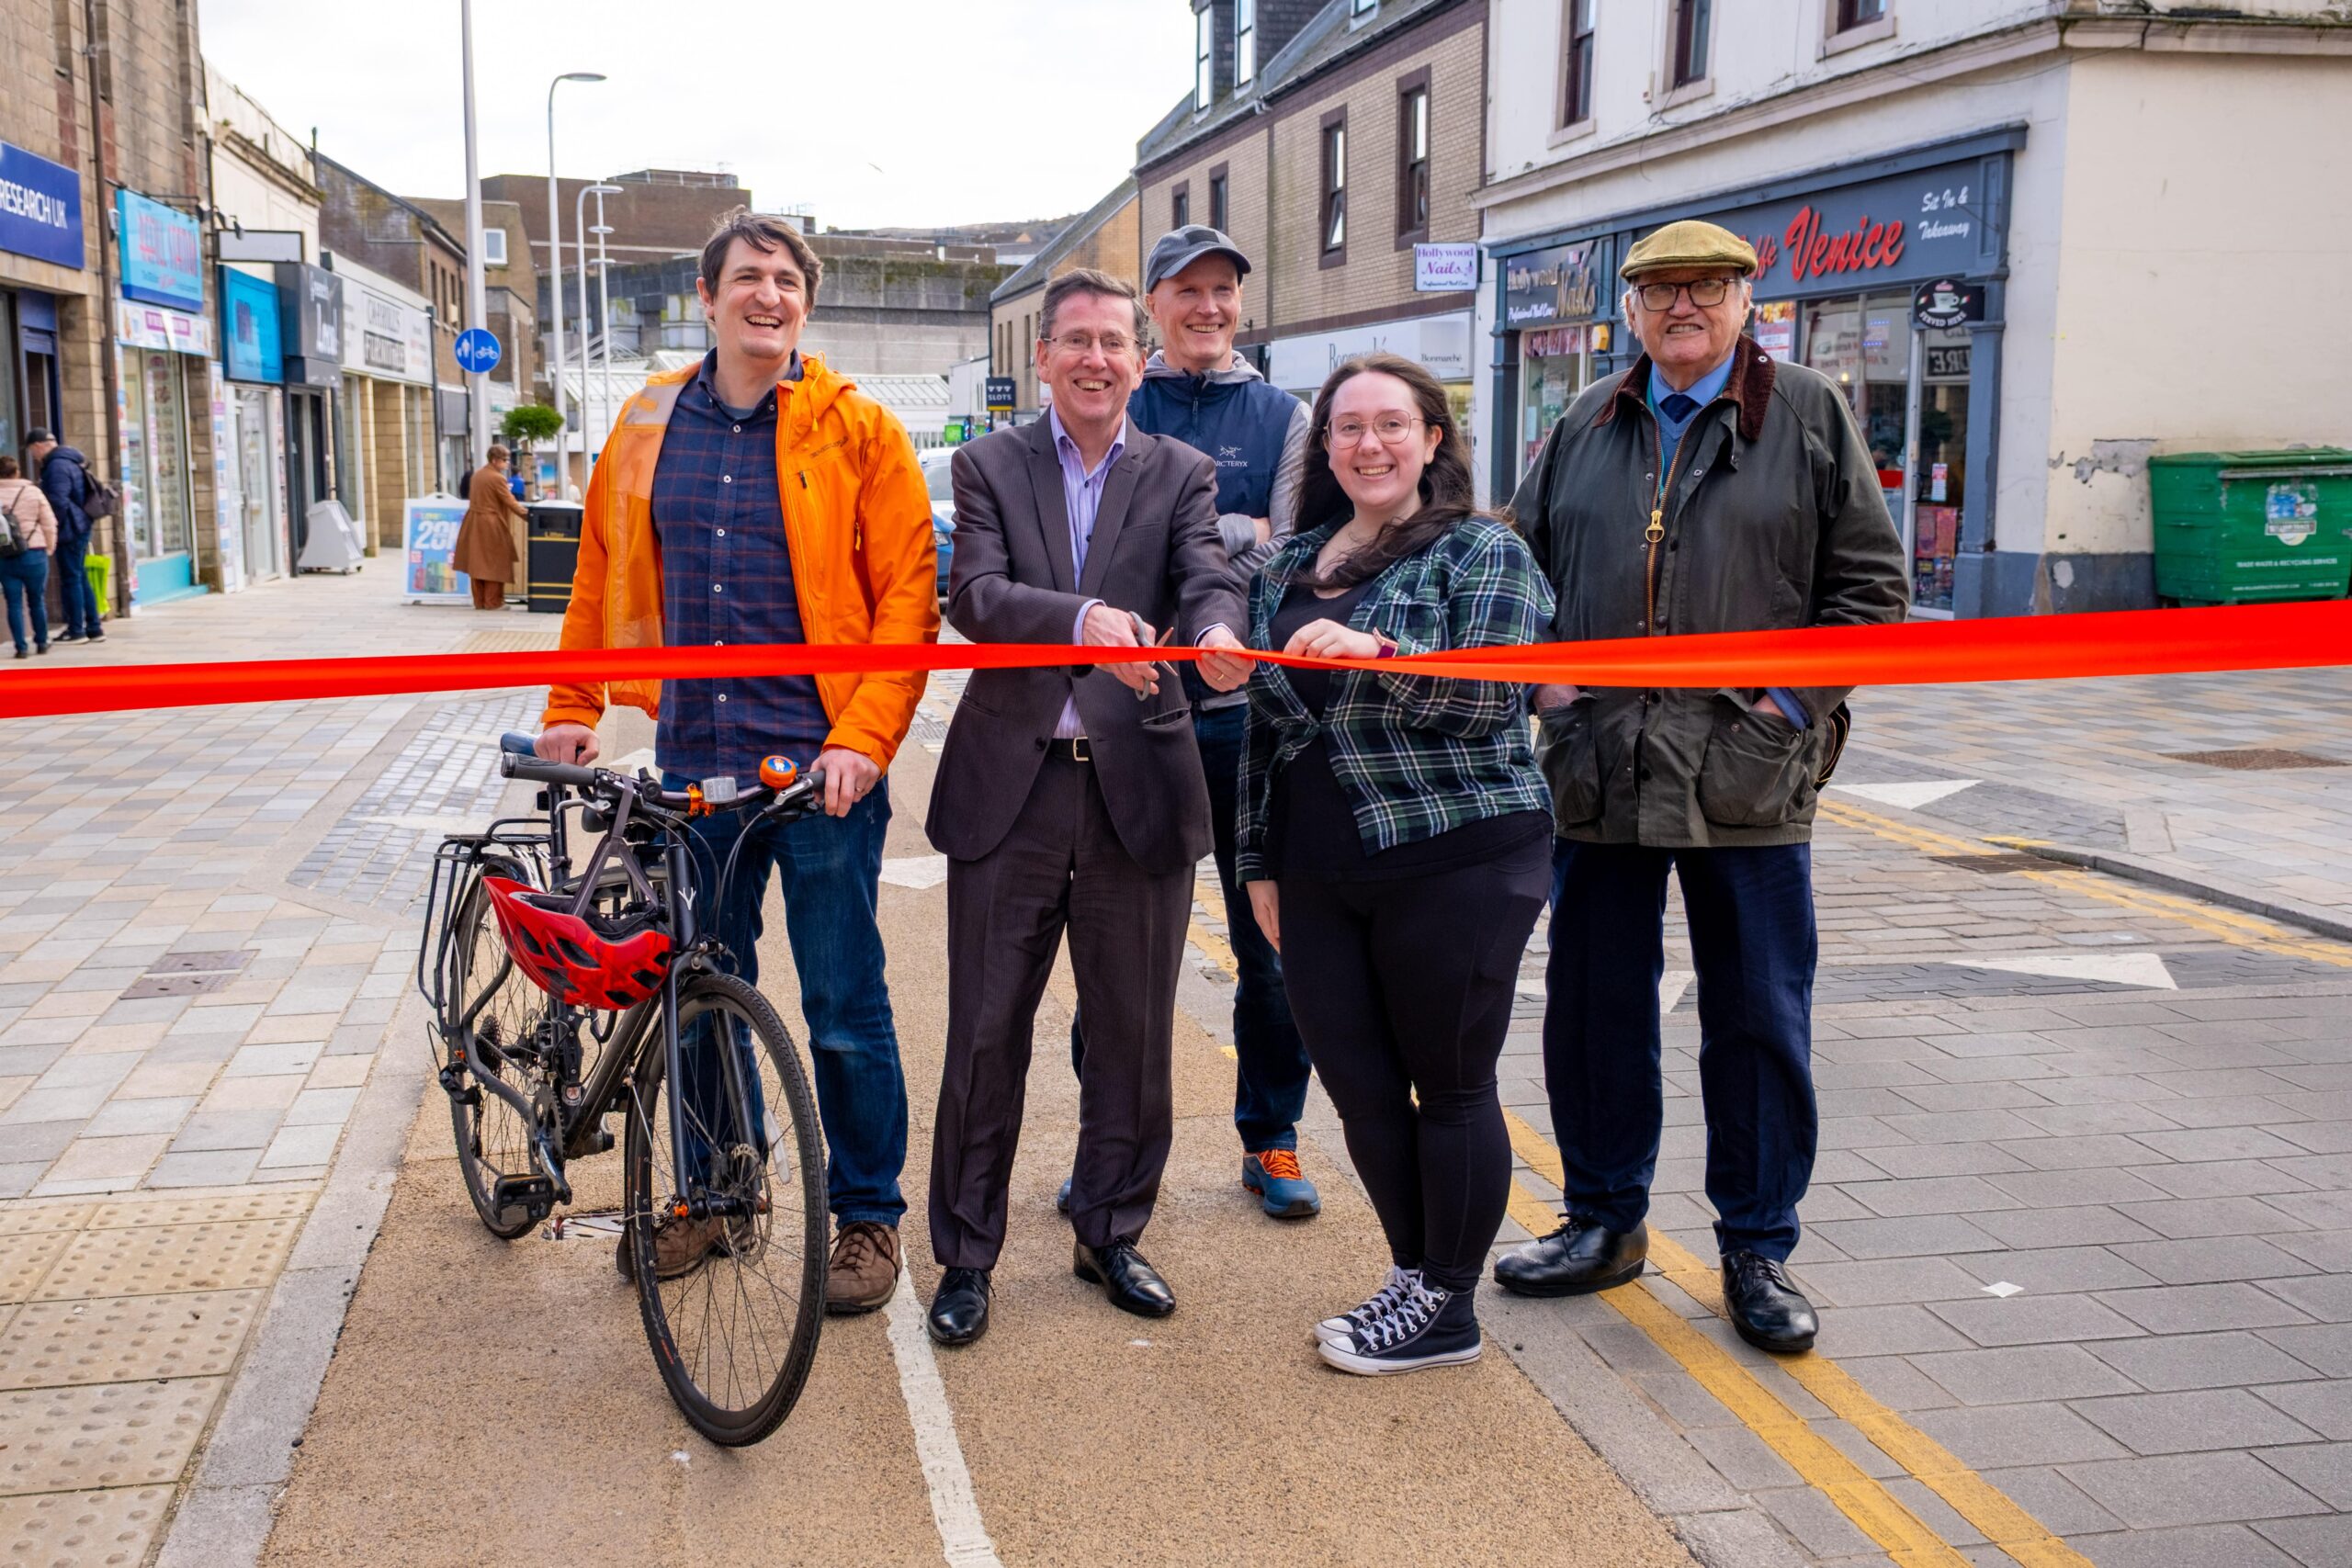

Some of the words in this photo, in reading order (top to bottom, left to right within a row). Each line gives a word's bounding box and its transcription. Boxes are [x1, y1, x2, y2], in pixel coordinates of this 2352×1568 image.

[1921, 191, 1939, 213] Sit
[1941, 188, 1956, 209] In
[1957, 186, 1969, 205] &
[51, 197, 68, 230] UK
[1918, 220, 1971, 241] Takeaway
[1418, 247, 1474, 258] Hollywood
[1783, 205, 1905, 281] Venice
[1421, 261, 1463, 275] Nails
[1507, 261, 1557, 294] Hollywood
[1556, 266, 1596, 318] Nails
[1919, 310, 1946, 327] SERVED
[1947, 310, 1967, 327] HERE
[1420, 353, 1463, 363] Bonmarché
